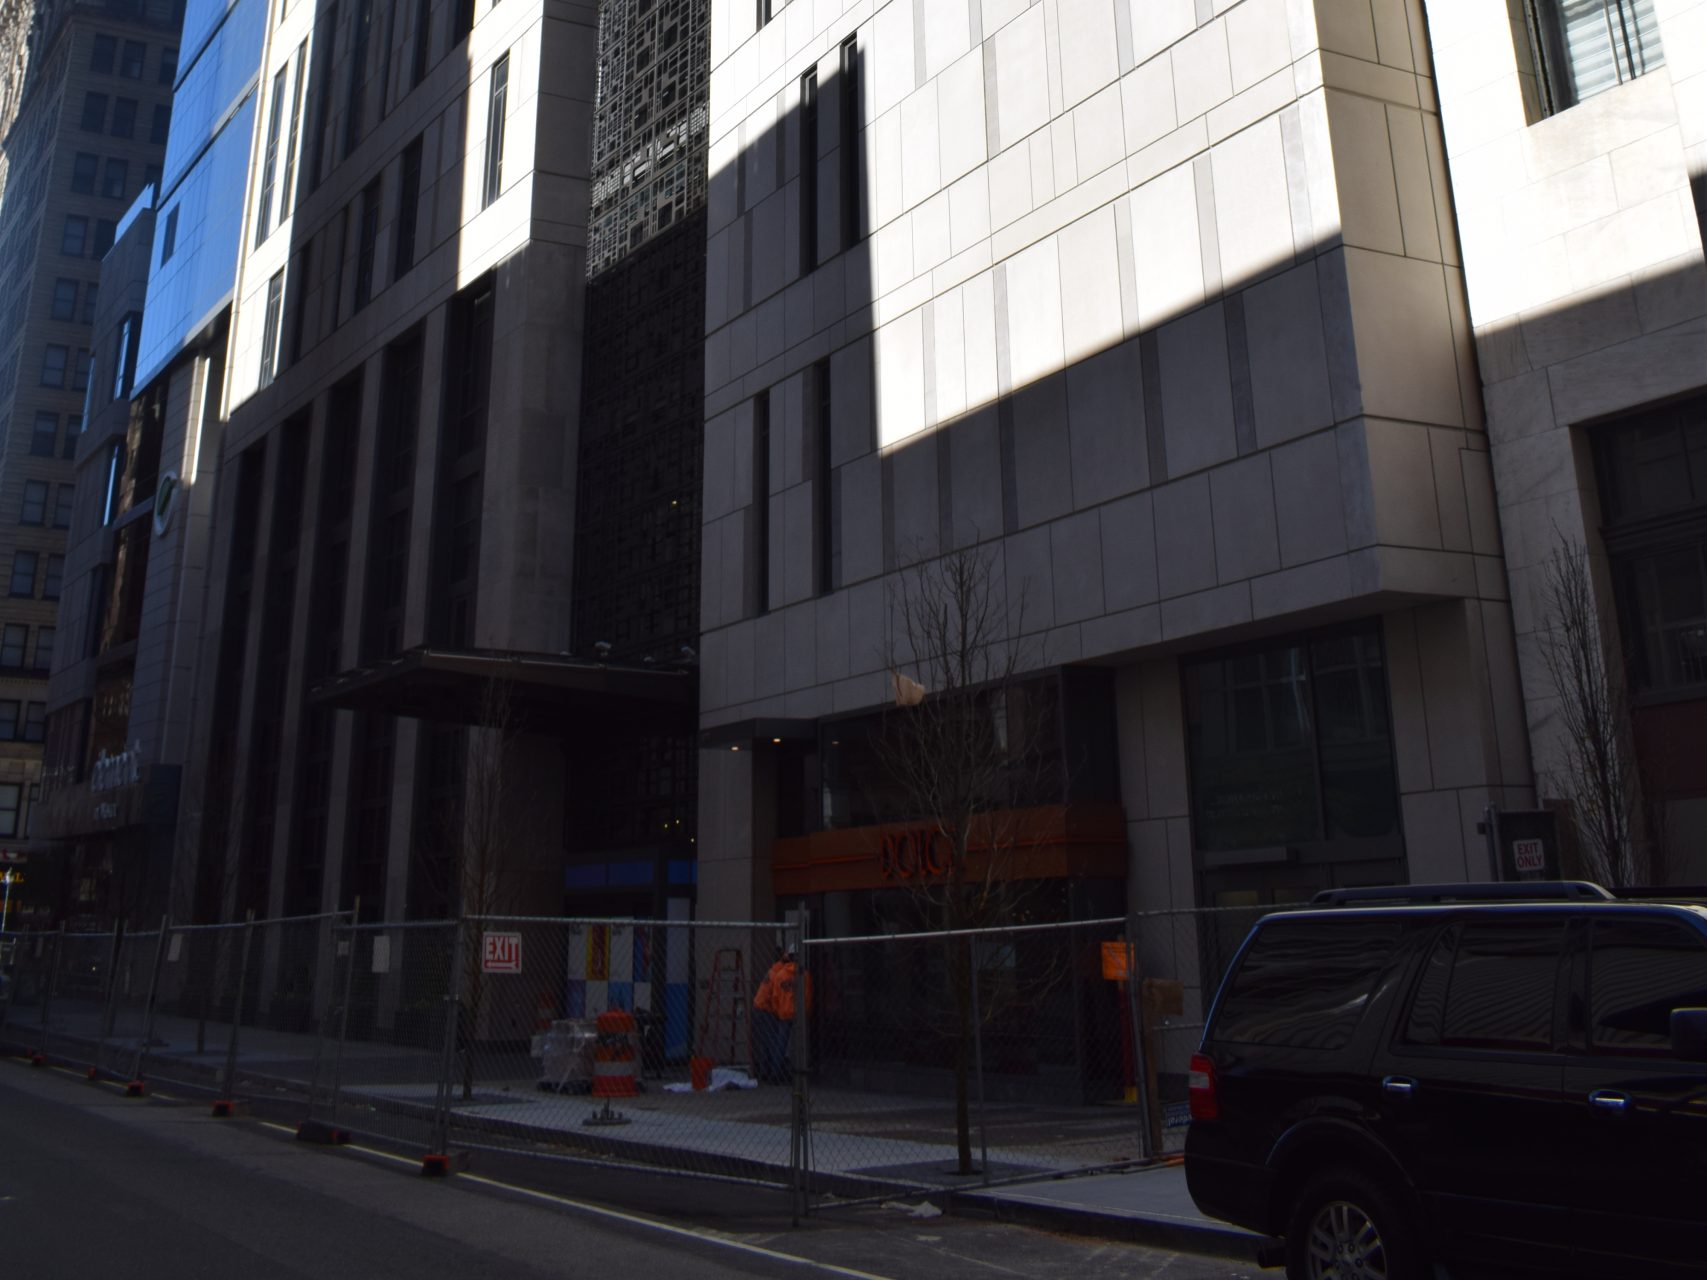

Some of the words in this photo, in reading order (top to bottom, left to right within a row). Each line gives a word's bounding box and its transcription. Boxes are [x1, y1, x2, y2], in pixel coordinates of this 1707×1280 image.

[1518, 842, 1538, 855] EXIT
[1518, 855, 1542, 868] ONLY
[485, 935, 519, 961] EXIT
